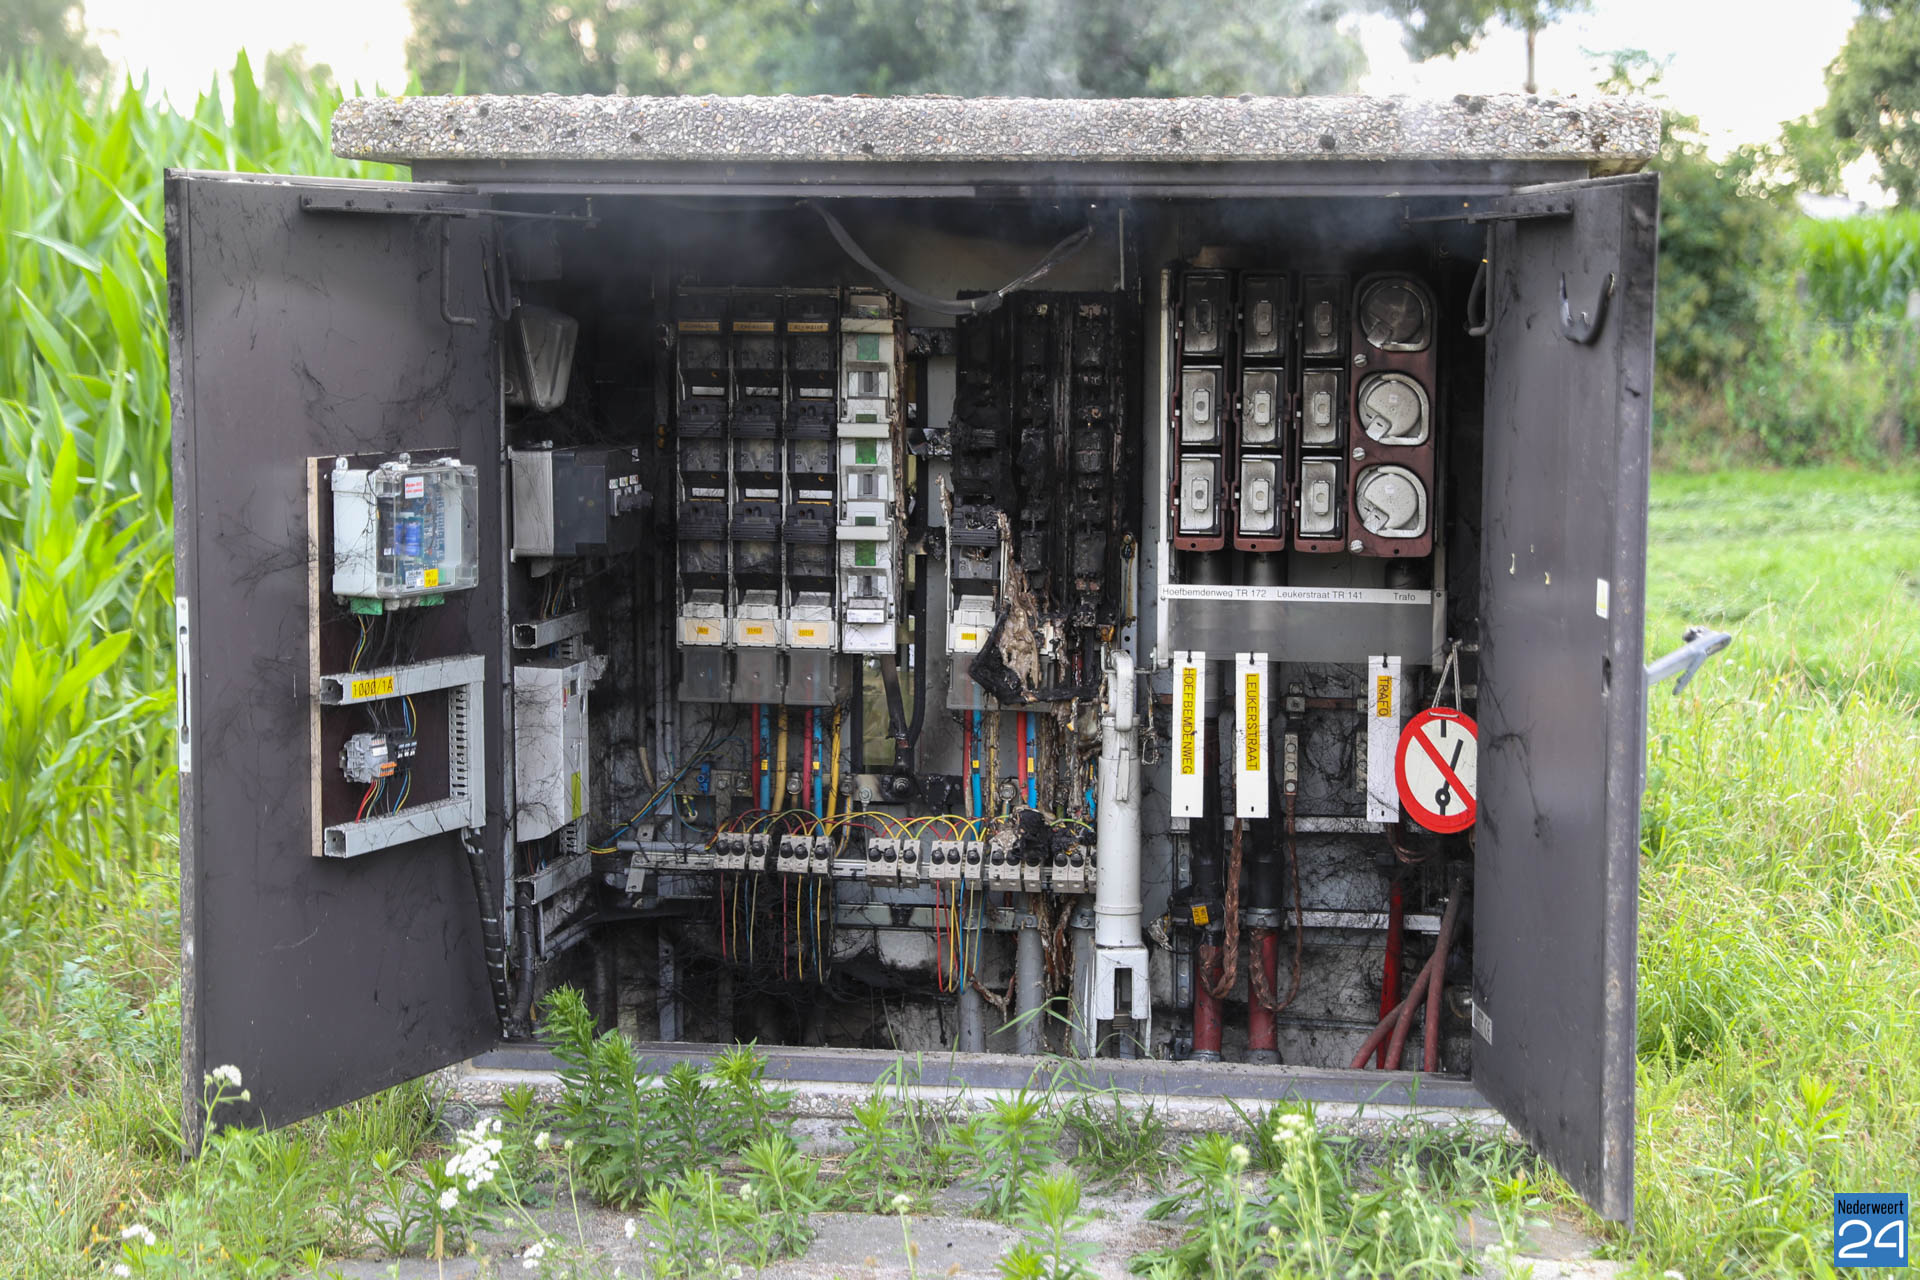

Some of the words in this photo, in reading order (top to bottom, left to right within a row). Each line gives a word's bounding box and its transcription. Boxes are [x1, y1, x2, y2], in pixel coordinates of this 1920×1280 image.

[1162, 588, 1233, 598] Hoefbemdenweg
[1236, 589, 1249, 597] TR
[1251, 589, 1267, 598] 172
[1277, 590, 1330, 599] Leukerstraat
[1332, 591, 1345, 599] TR
[1348, 591, 1363, 600] 141
[1393, 592, 1416, 601] Trafo
[353, 679, 393, 696] 1000/1A
[1378, 676, 1390, 717] TRAFO
[1182, 668, 1194, 774] HOEFBEMDENWEG
[1247, 674, 1258, 770] LEUKERSTRAAT
